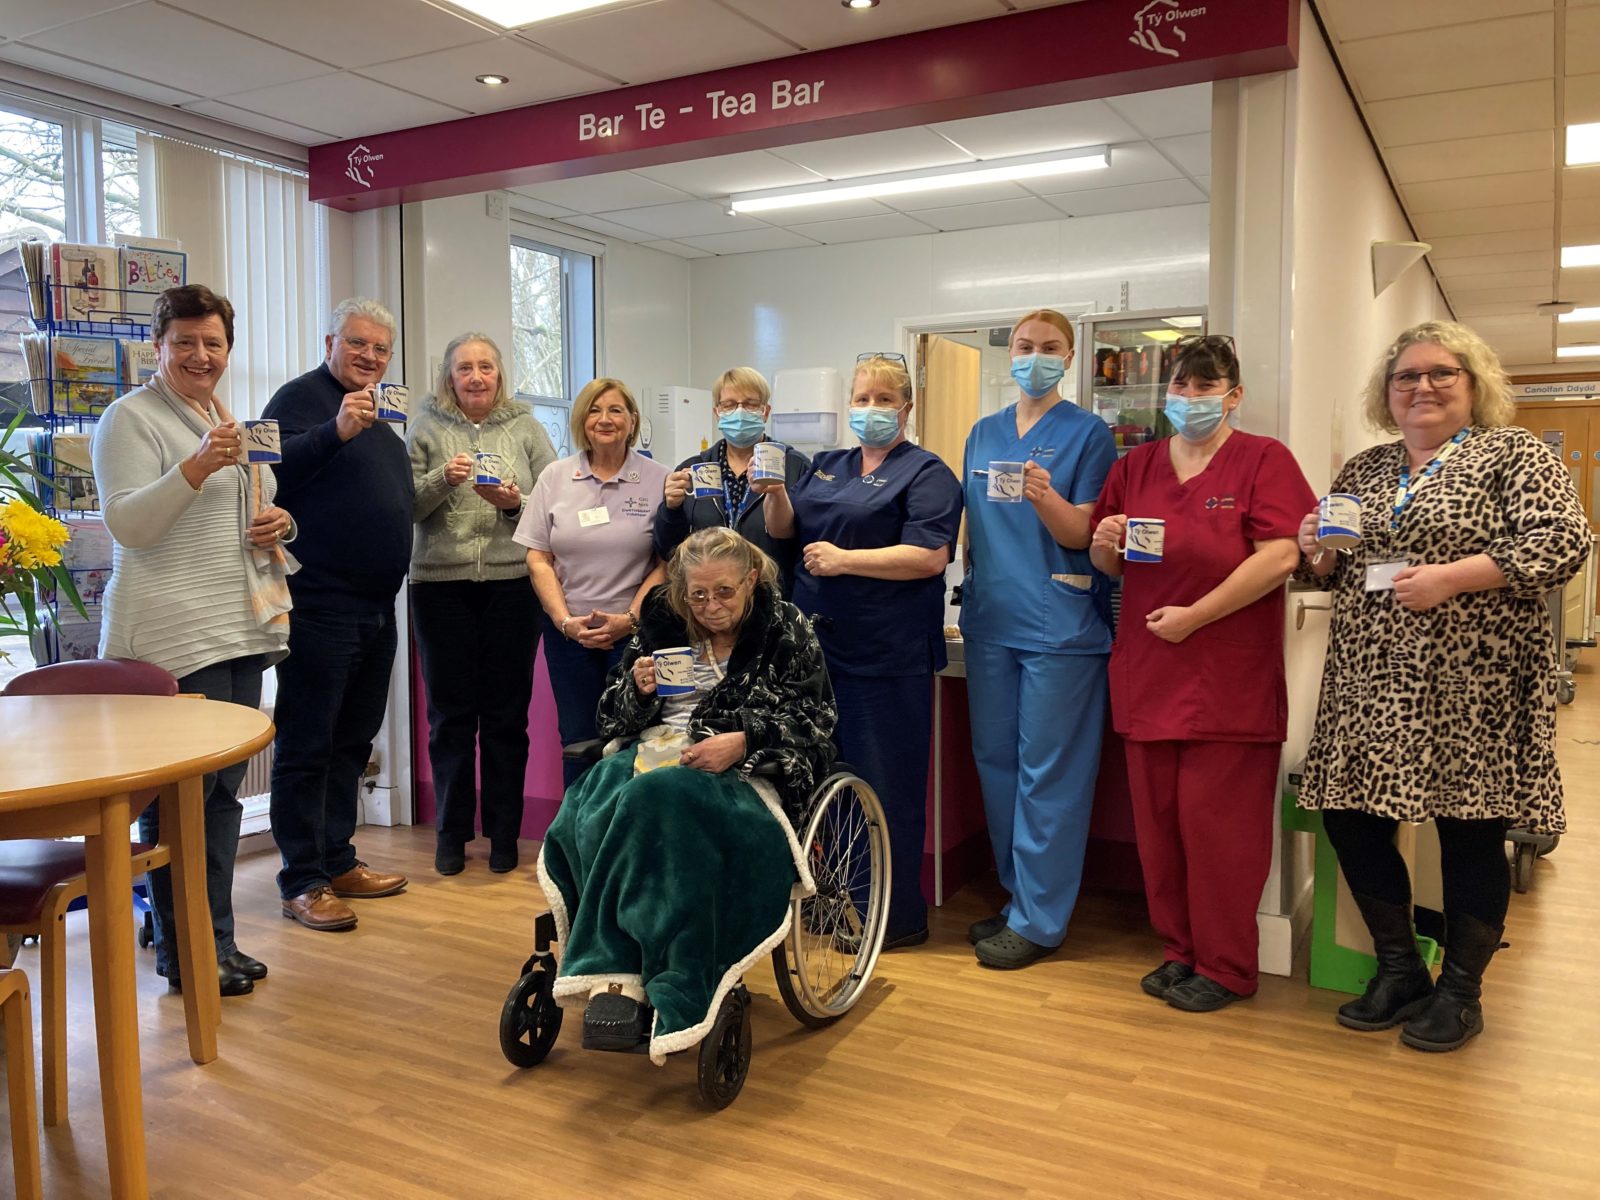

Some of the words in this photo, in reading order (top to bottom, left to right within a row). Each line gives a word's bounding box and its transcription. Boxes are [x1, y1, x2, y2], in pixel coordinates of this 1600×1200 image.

[1165, 6, 1206, 21] Olwen
[579, 113, 624, 141] Bar
[635, 102, 666, 131] Te
[706, 90, 756, 119] Tea
[771, 79, 825, 110] Bar
[363, 154, 384, 163] Olwen
[132, 350, 155, 358] HAPP
[1524, 386, 1563, 394] Canolfan
[1566, 384, 1596, 393] Ddydd
